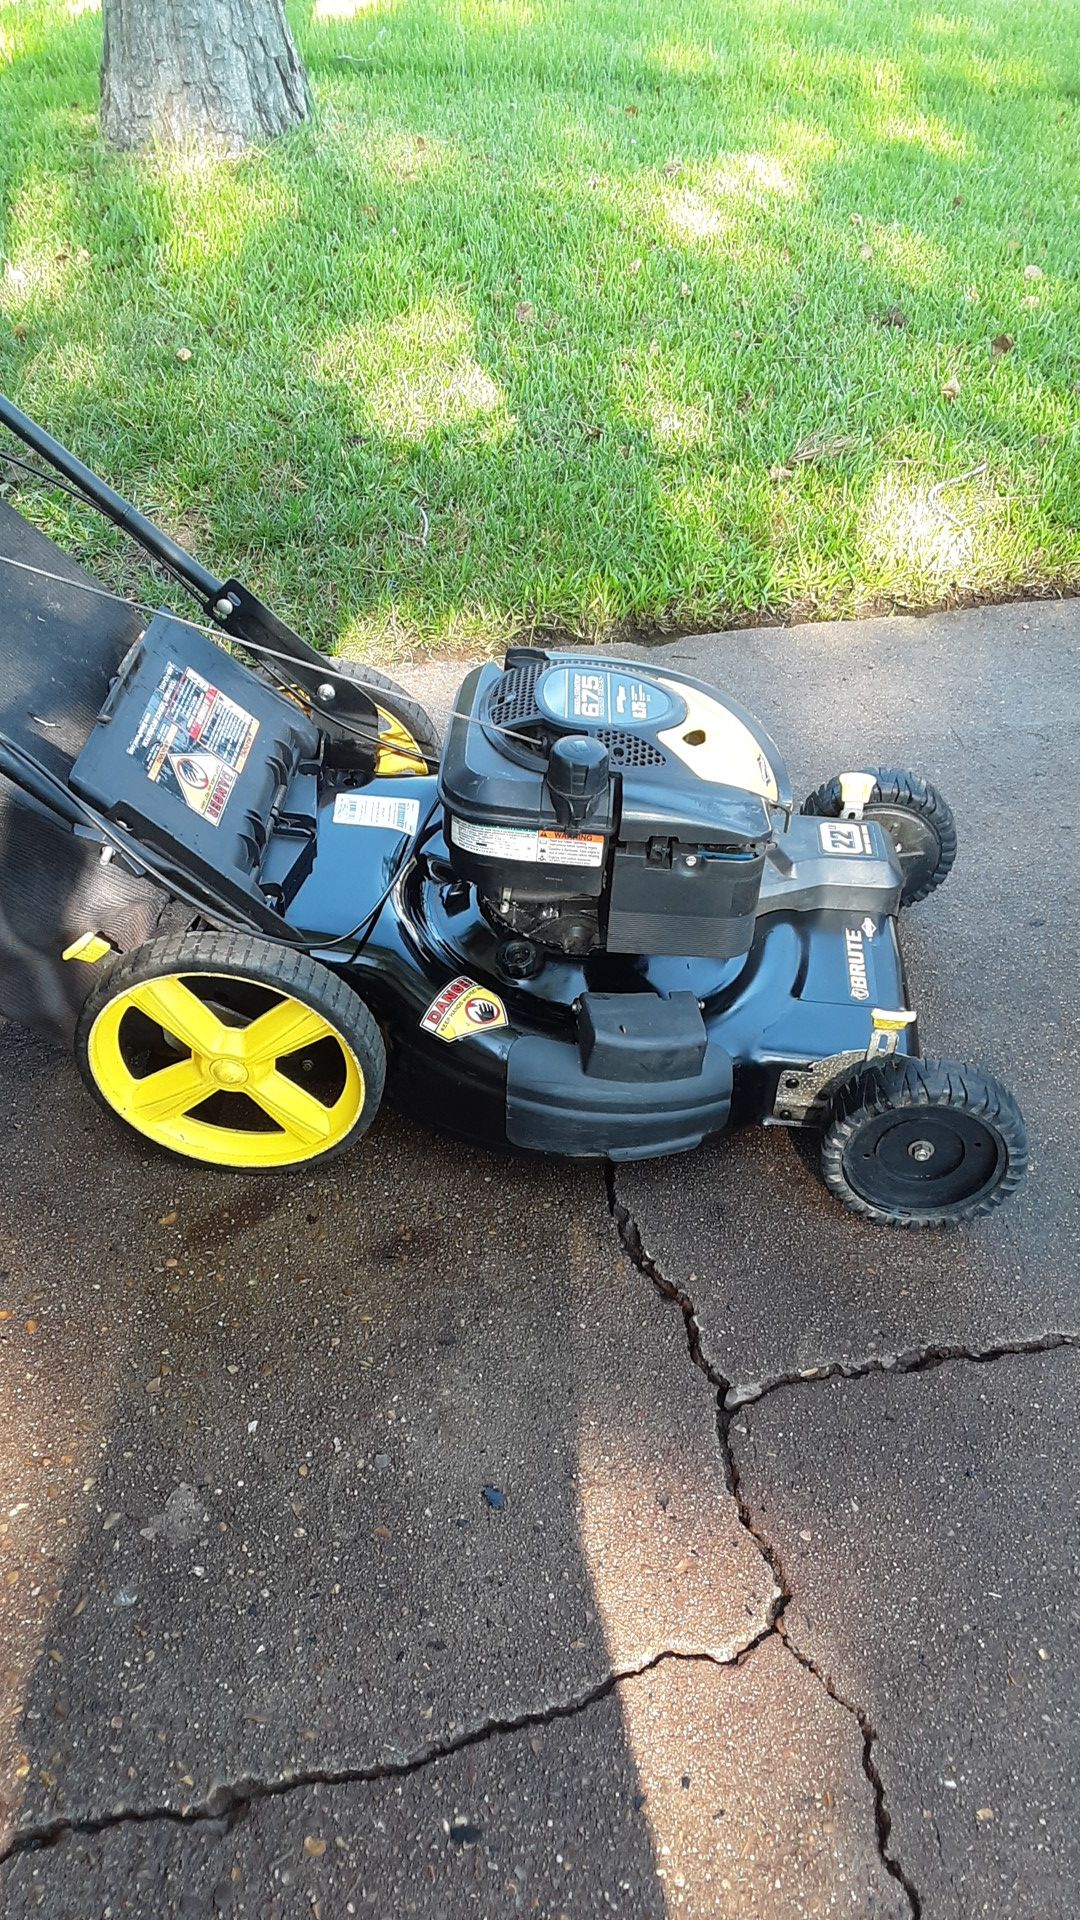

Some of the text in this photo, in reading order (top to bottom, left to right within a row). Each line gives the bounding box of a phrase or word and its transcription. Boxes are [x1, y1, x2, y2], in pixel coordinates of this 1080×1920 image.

[581, 675, 600, 717] 675
[205, 769, 233, 819] DANGER
[846, 927, 870, 989] BRUTE
